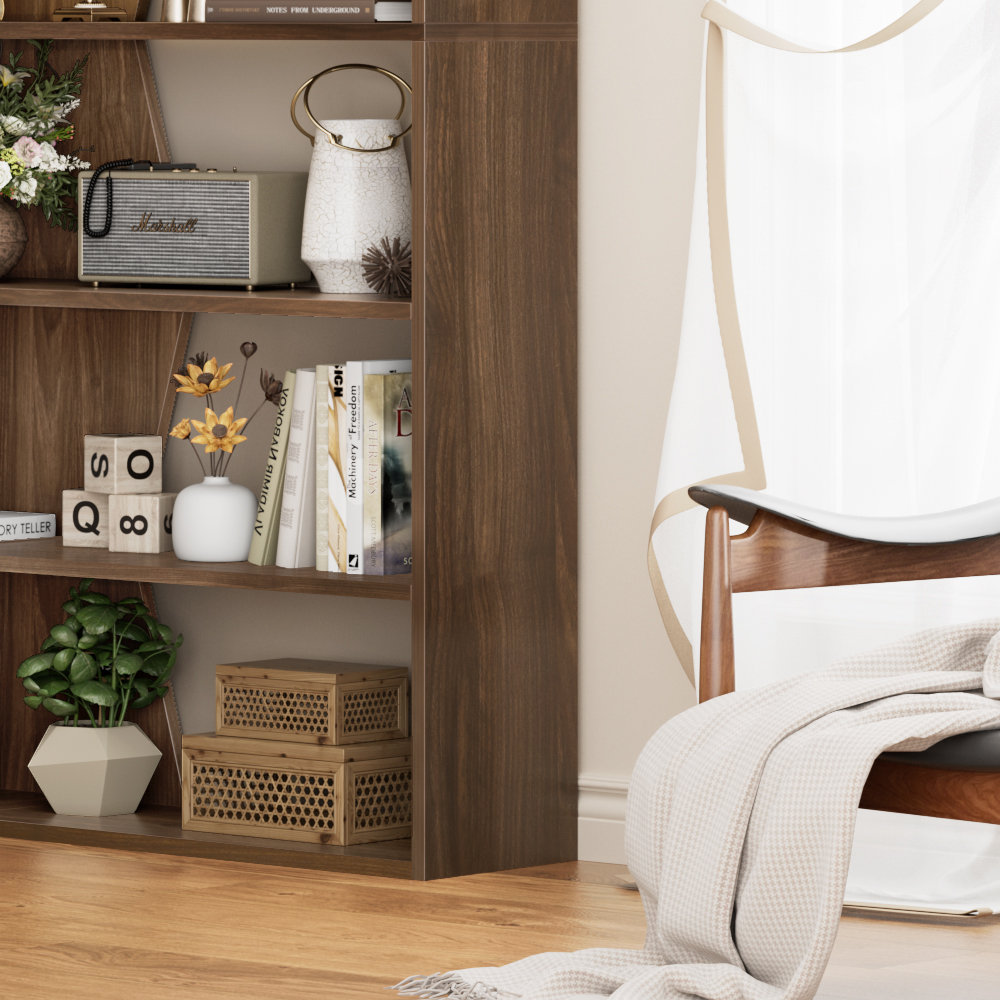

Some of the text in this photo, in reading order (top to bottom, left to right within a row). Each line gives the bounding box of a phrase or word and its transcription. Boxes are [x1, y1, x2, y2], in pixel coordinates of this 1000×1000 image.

[266, 6, 287, 14] NOTES
[290, 6, 309, 14] FROM
[312, 6, 360, 14] UNDERGROUND
[130, 211, 198, 233] Marshall
[348, 385, 357, 434] Freedom
[348, 444, 358, 499] Machinery
[20, 521, 51, 534] TELLER
[73, 500, 100, 536] Q
[120, 515, 148, 536] 8
